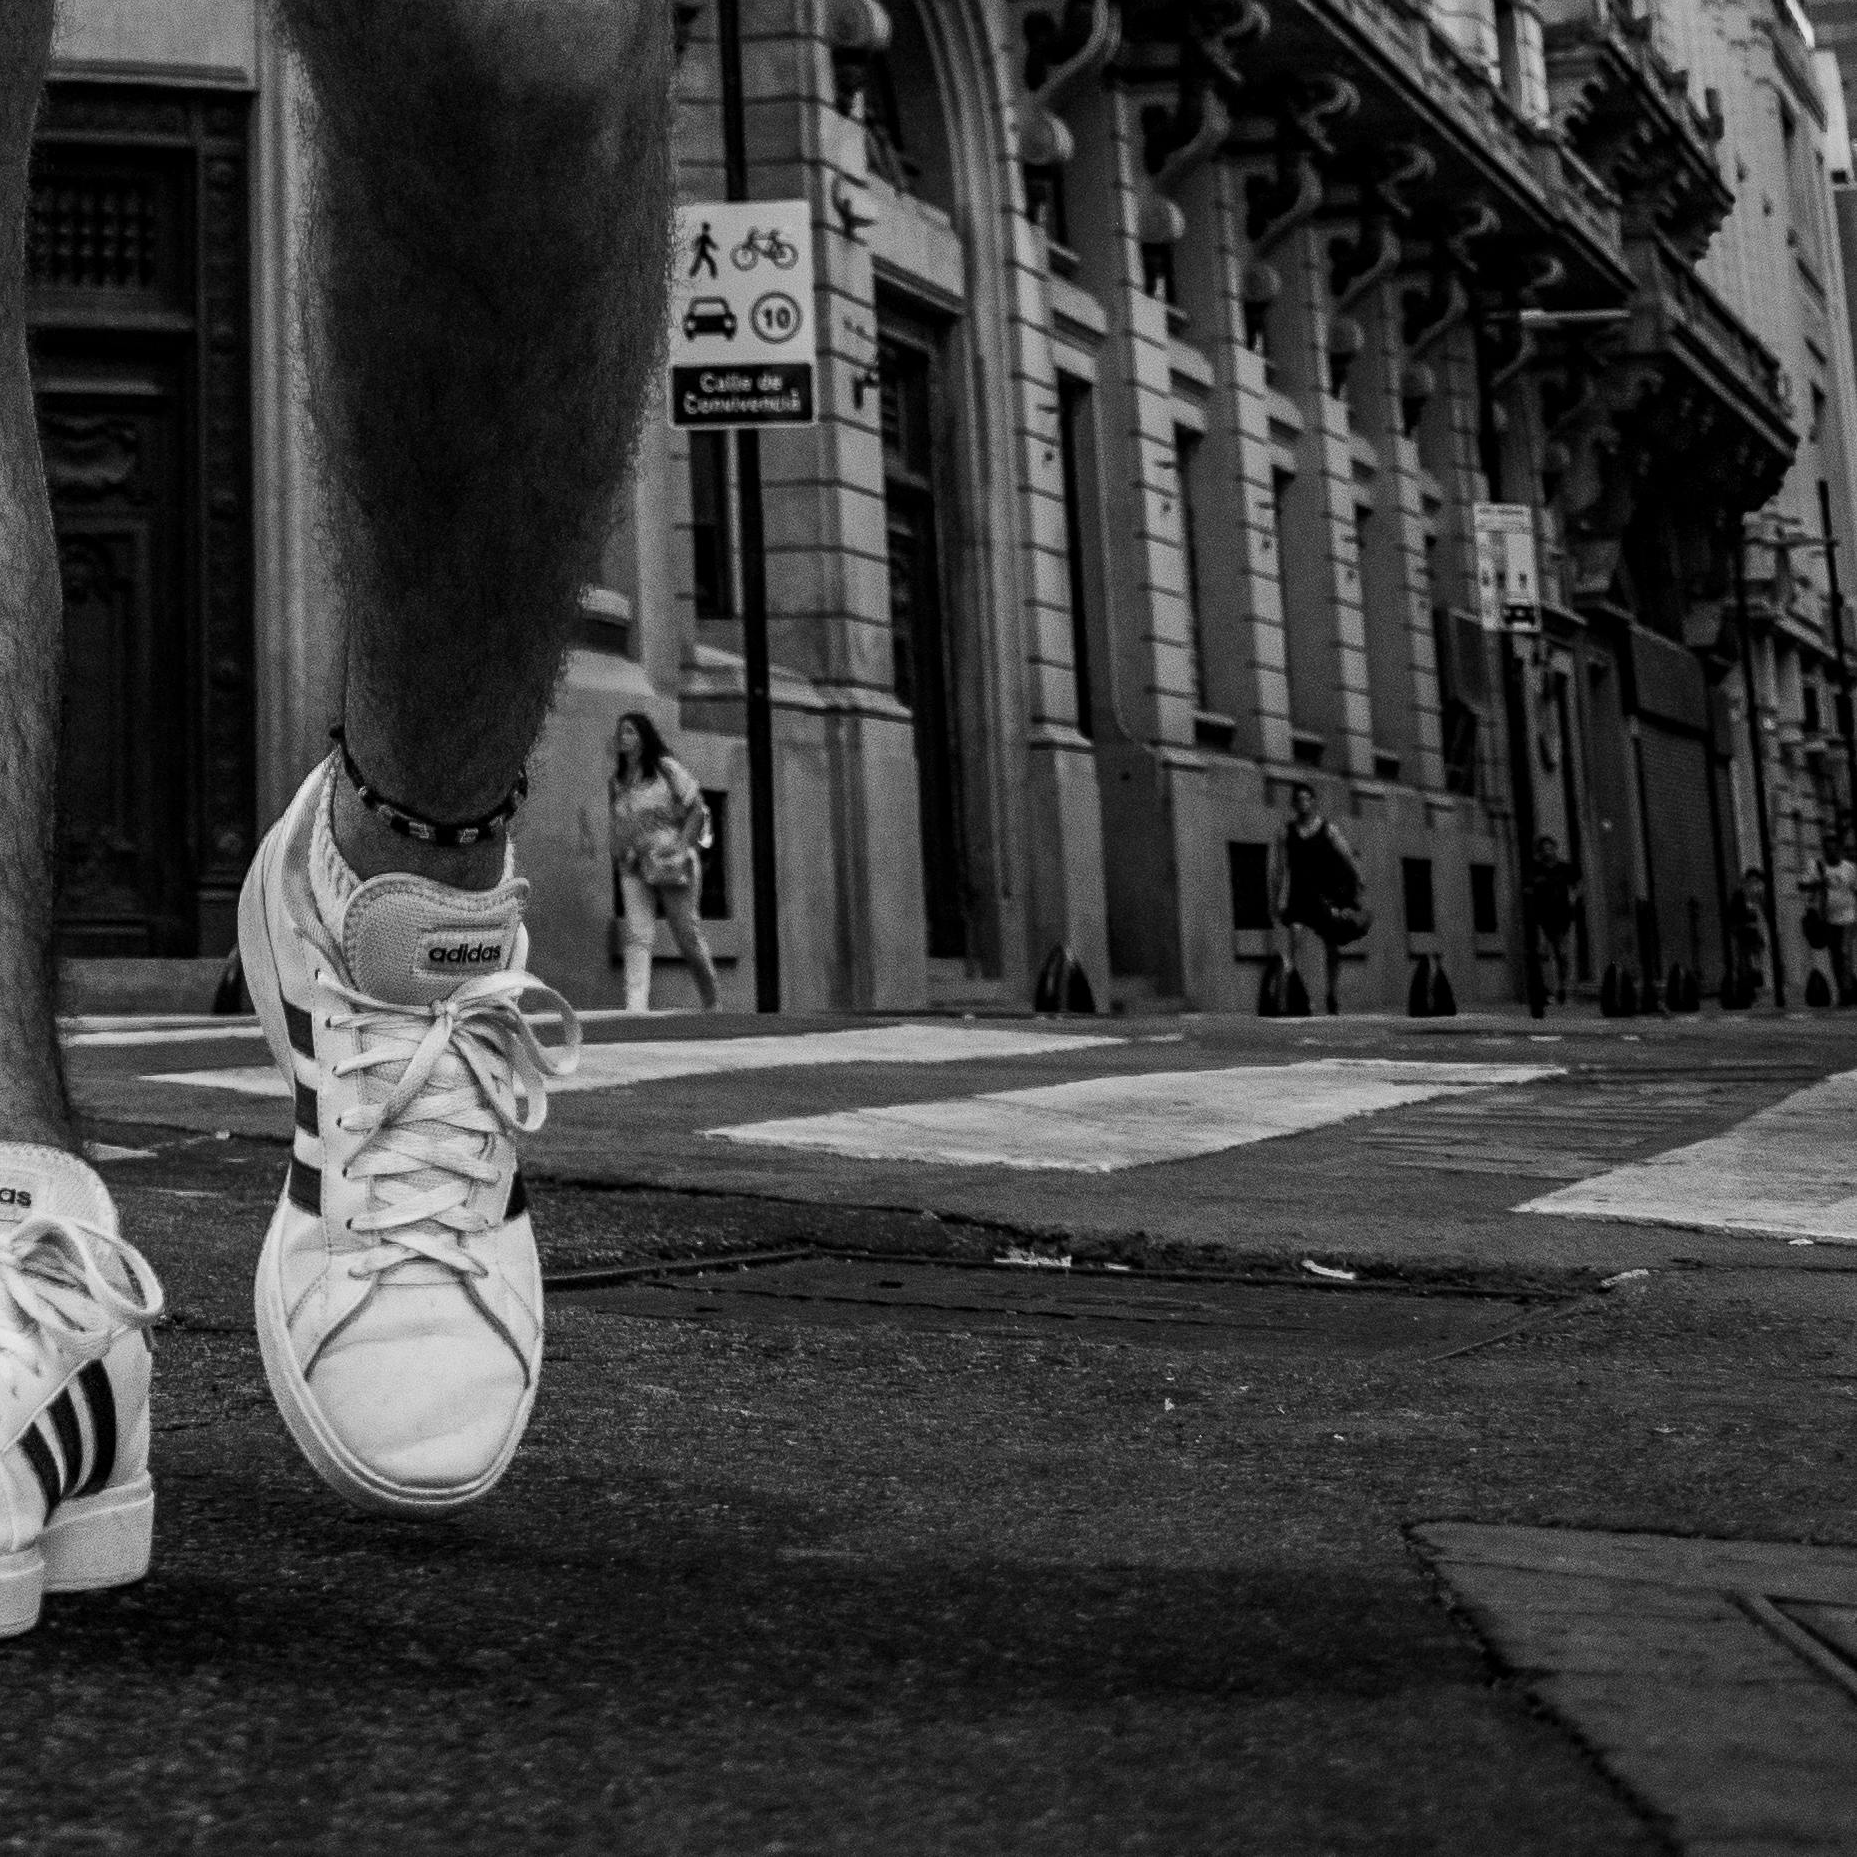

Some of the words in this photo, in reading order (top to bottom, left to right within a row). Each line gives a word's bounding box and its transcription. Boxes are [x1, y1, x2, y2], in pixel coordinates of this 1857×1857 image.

[762, 306, 792, 331] 10
[699, 372, 752, 393] Calle
[756, 373, 784, 392] de
[428, 942, 502, 964] adidas
